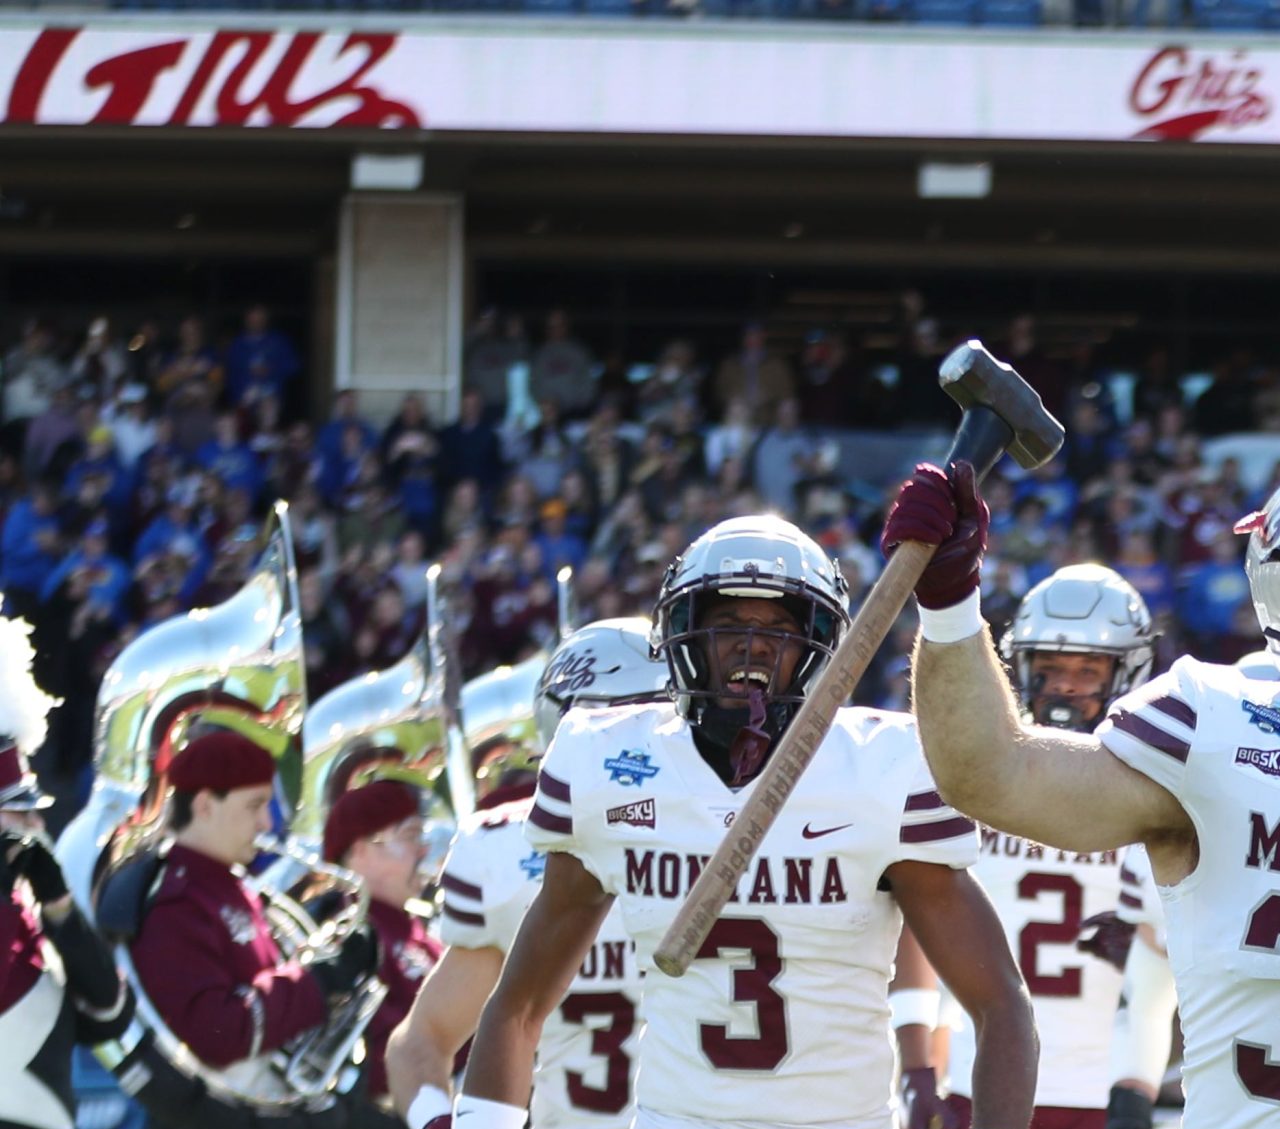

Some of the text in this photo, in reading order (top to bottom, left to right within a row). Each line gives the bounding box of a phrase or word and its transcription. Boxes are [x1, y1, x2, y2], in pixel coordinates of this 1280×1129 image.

[1130, 46, 1272, 140] Griz
[541, 647, 598, 691] Griz
[624, 847, 849, 905] MONANA
[1016, 871, 1084, 998] 2
[694, 915, 791, 1073] 3
